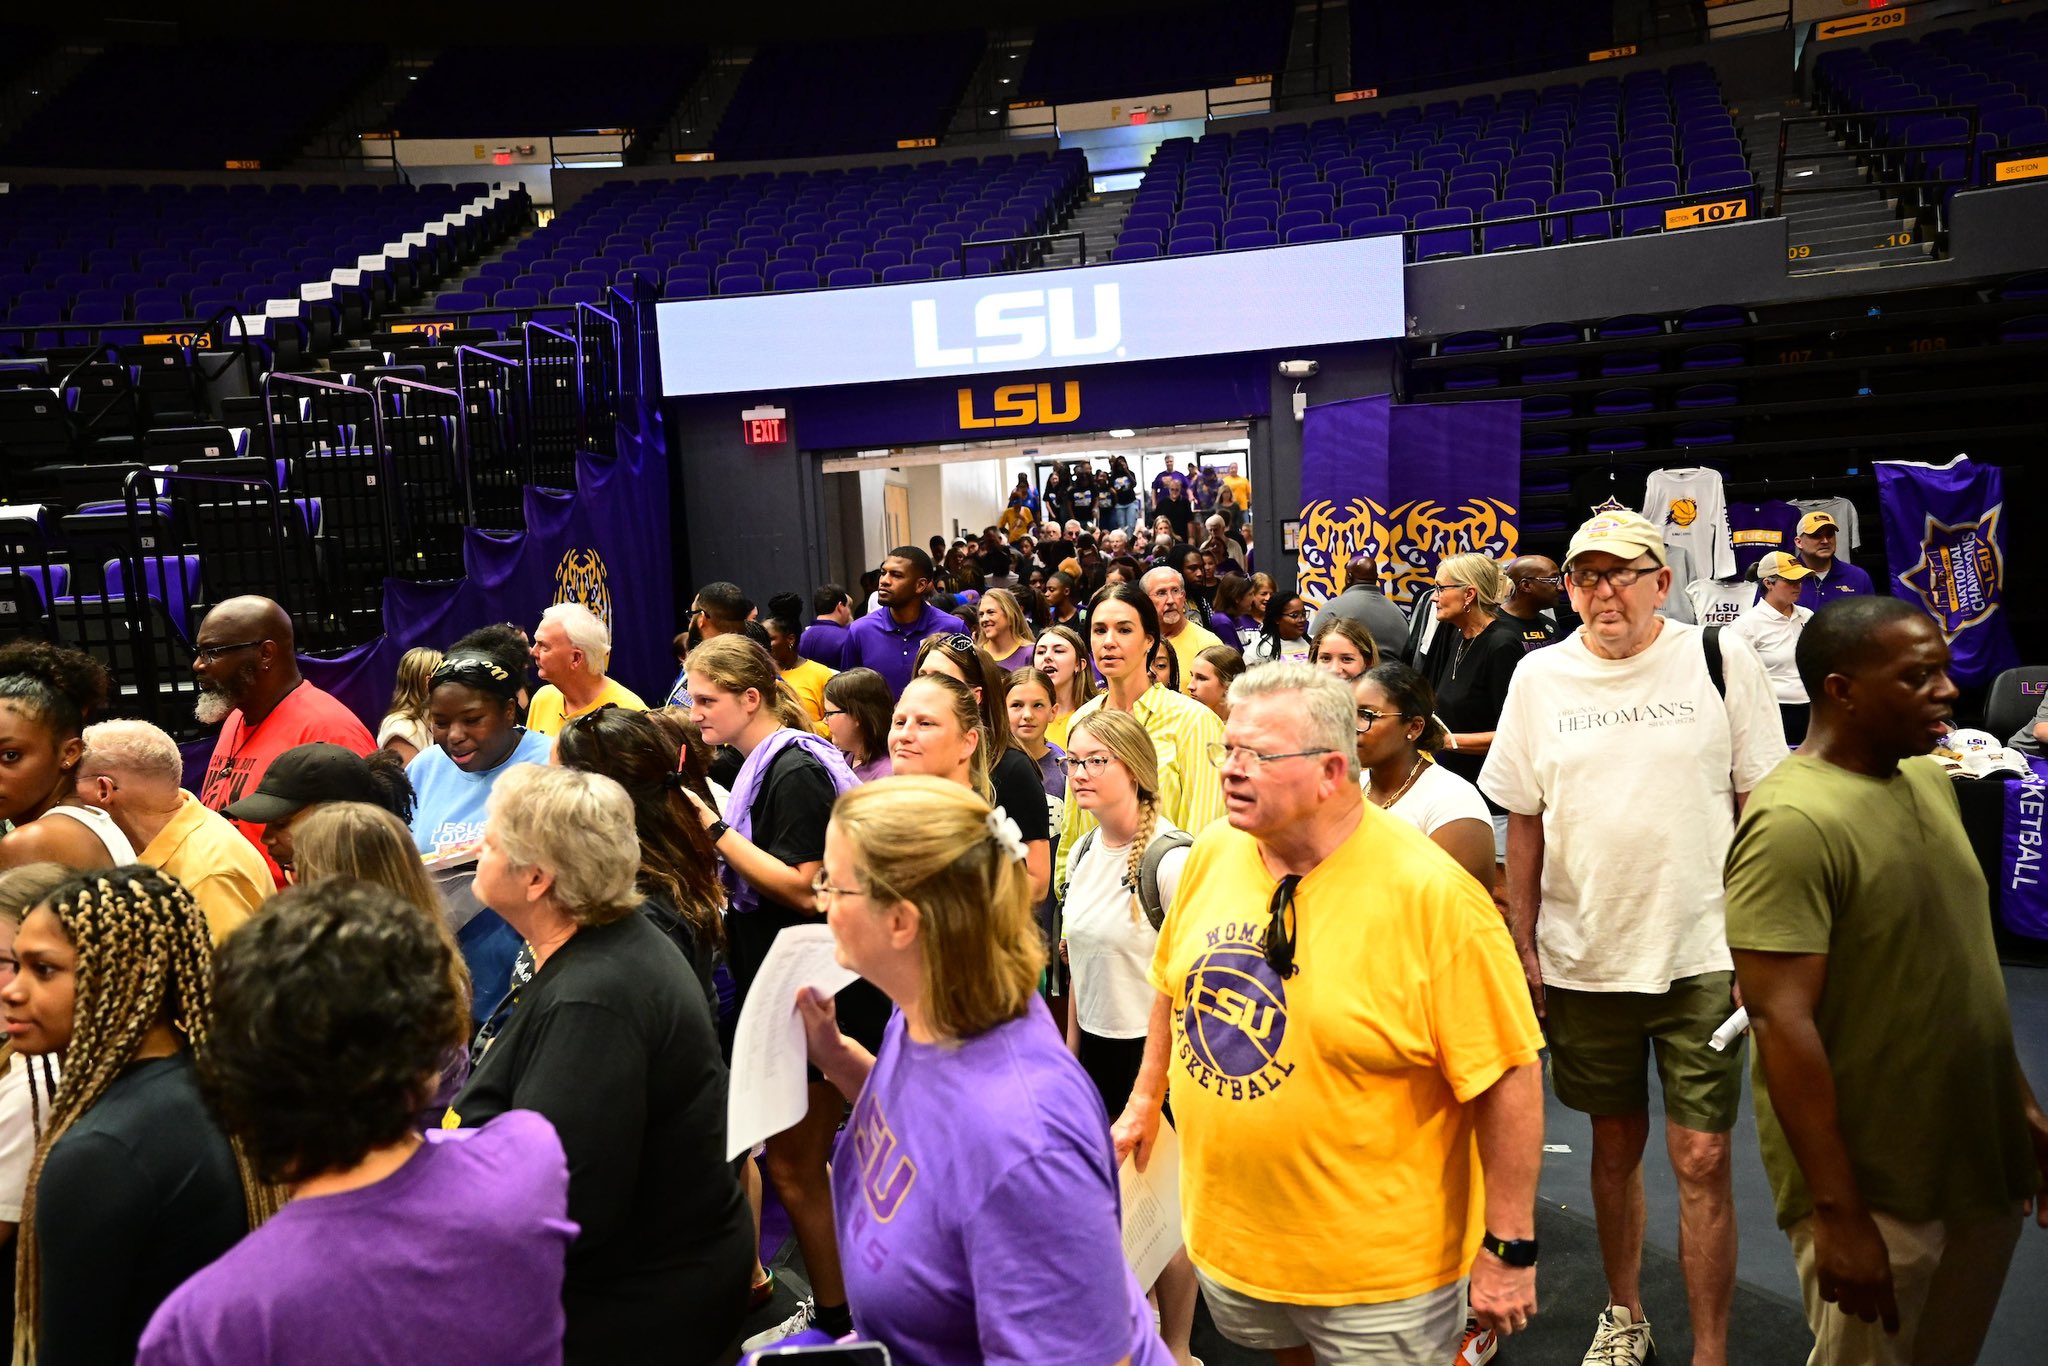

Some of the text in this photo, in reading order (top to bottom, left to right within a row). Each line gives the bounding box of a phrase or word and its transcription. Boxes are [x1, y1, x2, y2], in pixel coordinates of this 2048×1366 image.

[1871, 13, 1903, 27] 209
[2005, 163, 2039, 174] SECTION
[1693, 202, 1743, 222] 107
[912, 283, 1121, 368] LSU
[958, 381, 1081, 429] LSU
[751, 419, 780, 443] EXIT
[1737, 532, 1779, 541] TIGERS
[1950, 543, 1970, 608] NATIONAL
[1961, 531, 1986, 612] CHAMPIONS
[1977, 547, 1995, 583] LSU
[1715, 603, 1739, 612] LSU
[1523, 631, 1546, 640] LSU
[1559, 701, 1694, 733] HEROMAN'S
[1967, 738, 1986, 746] LSU
[1191, 976, 1276, 1039] LSU
[1175, 1008, 1295, 1101] BASKETBALL
